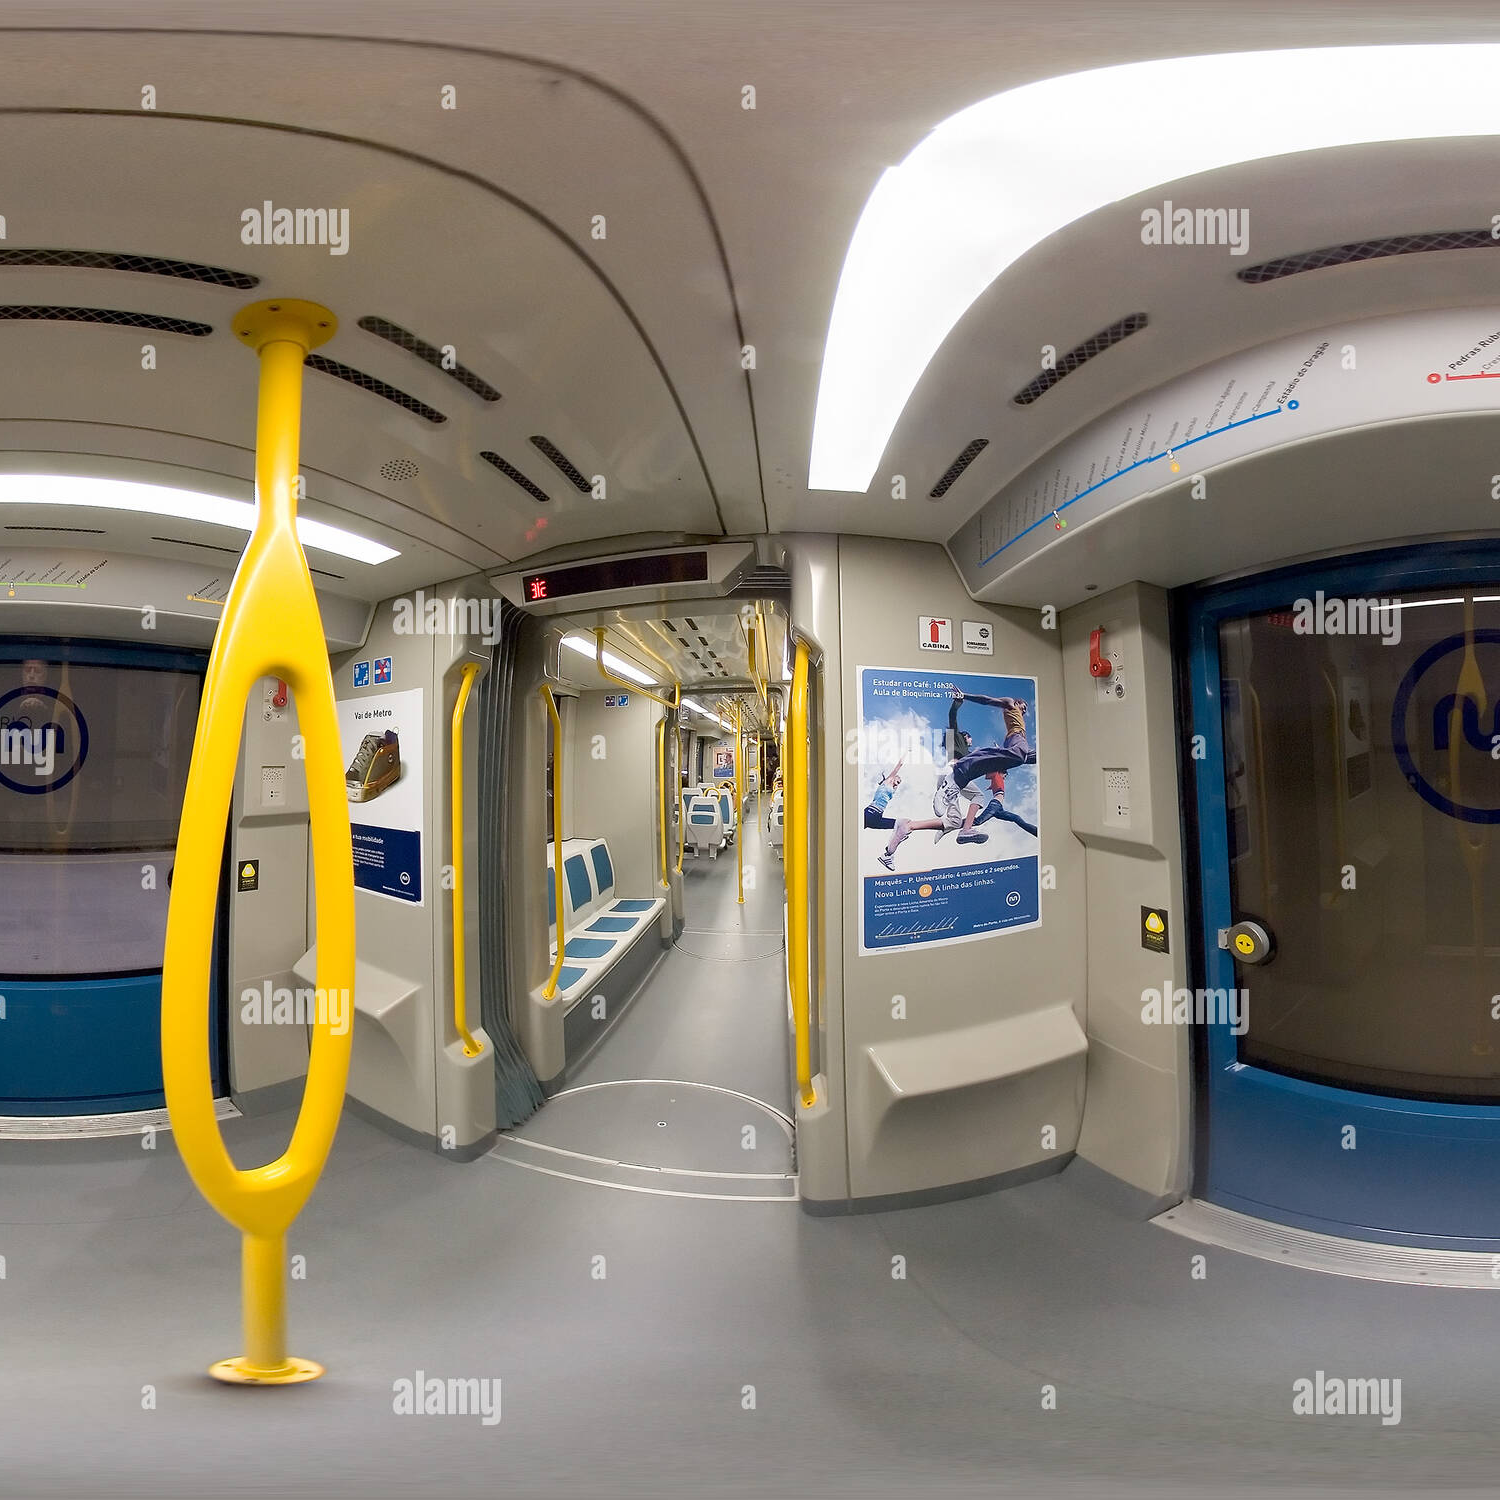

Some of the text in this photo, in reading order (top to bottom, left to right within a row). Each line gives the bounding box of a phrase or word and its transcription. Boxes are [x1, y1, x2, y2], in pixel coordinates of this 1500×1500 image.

[1448, 347, 1481, 371] Pedras
[1277, 377, 1300, 405] Estádio
[1303, 341, 1330, 369] Dragão
[922, 642, 950, 650] CABINA
[873, 678, 901, 687] Estudar
[913, 680, 932, 689] Café:
[933, 682, 954, 690] 16h30
[873, 688, 890, 696] Aula
[891, 689, 900, 697] de
[902, 689, 943, 699] Bioquímica:
[373, 709, 392, 718] Metro
[874, 878, 902, 887] Marquês
[915, 872, 956, 883] Universitário:
[961, 868, 984, 877] minutos
[993, 864, 1020, 873] segundos.
[896, 889, 916, 897] Linha
[942, 883, 959, 891] linha
[960, 881, 973, 889] das
[973, 879, 995, 887] linhas.
